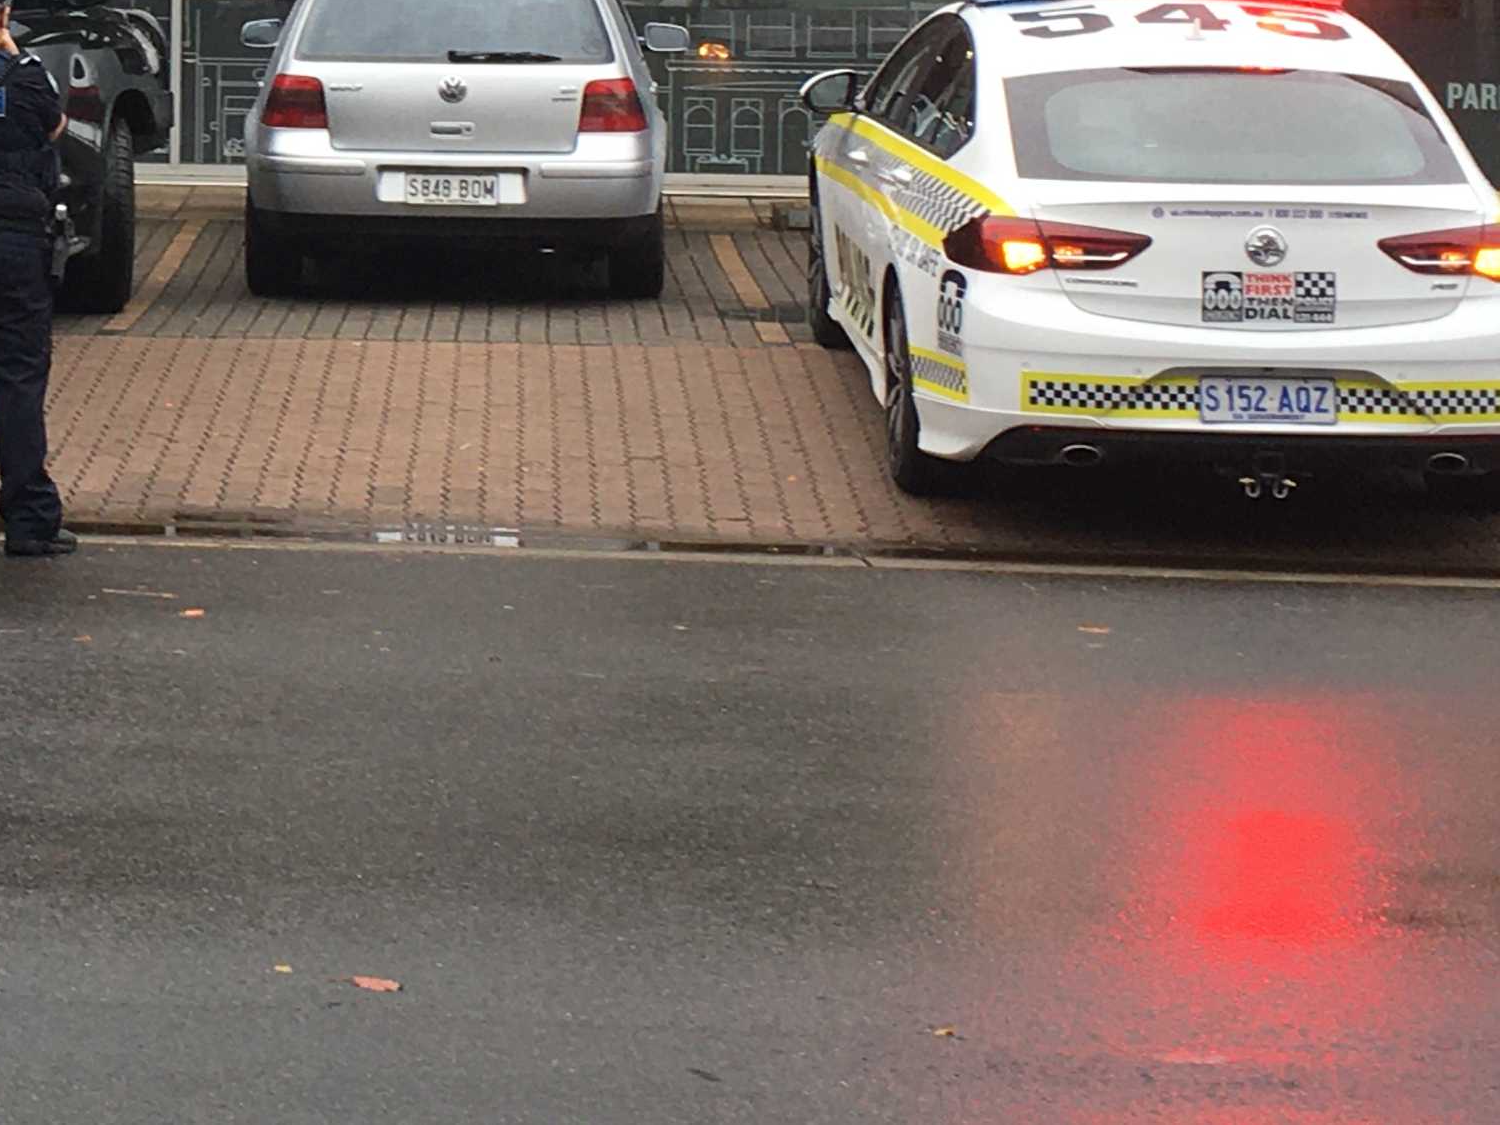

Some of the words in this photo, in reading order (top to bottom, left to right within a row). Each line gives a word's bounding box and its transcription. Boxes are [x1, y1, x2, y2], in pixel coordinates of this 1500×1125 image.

[1447, 82, 1500, 111] PAR
[1245, 274, 1292, 283] THINK
[1245, 285, 1293, 296] FIRST
[1246, 297, 1294, 306] THEN
[1245, 308, 1293, 320] DIAL
